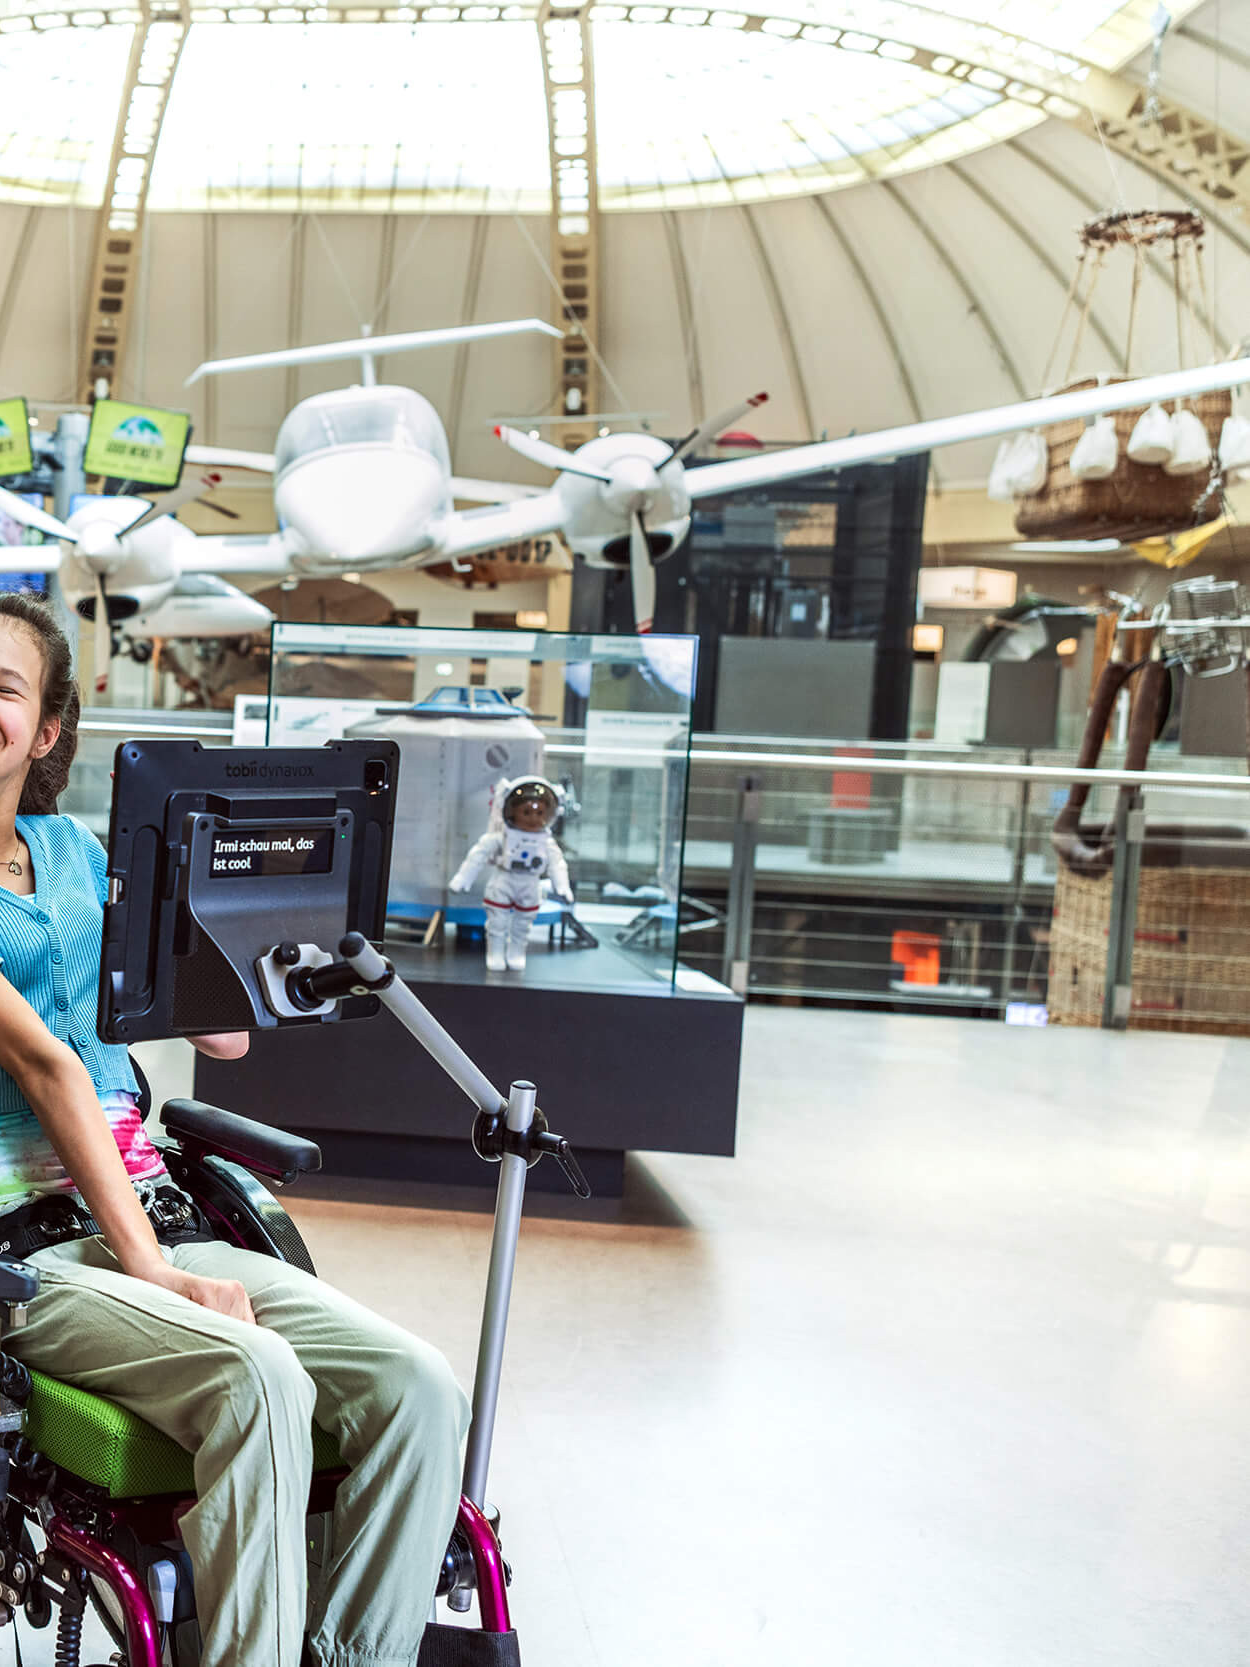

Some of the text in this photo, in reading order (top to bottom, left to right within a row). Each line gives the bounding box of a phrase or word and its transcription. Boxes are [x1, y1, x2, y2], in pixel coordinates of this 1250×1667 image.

[224, 760, 316, 778] tobii dynavox
[214, 836, 315, 853] Irmi schau mal, das
[213, 855, 252, 871] ist cool
